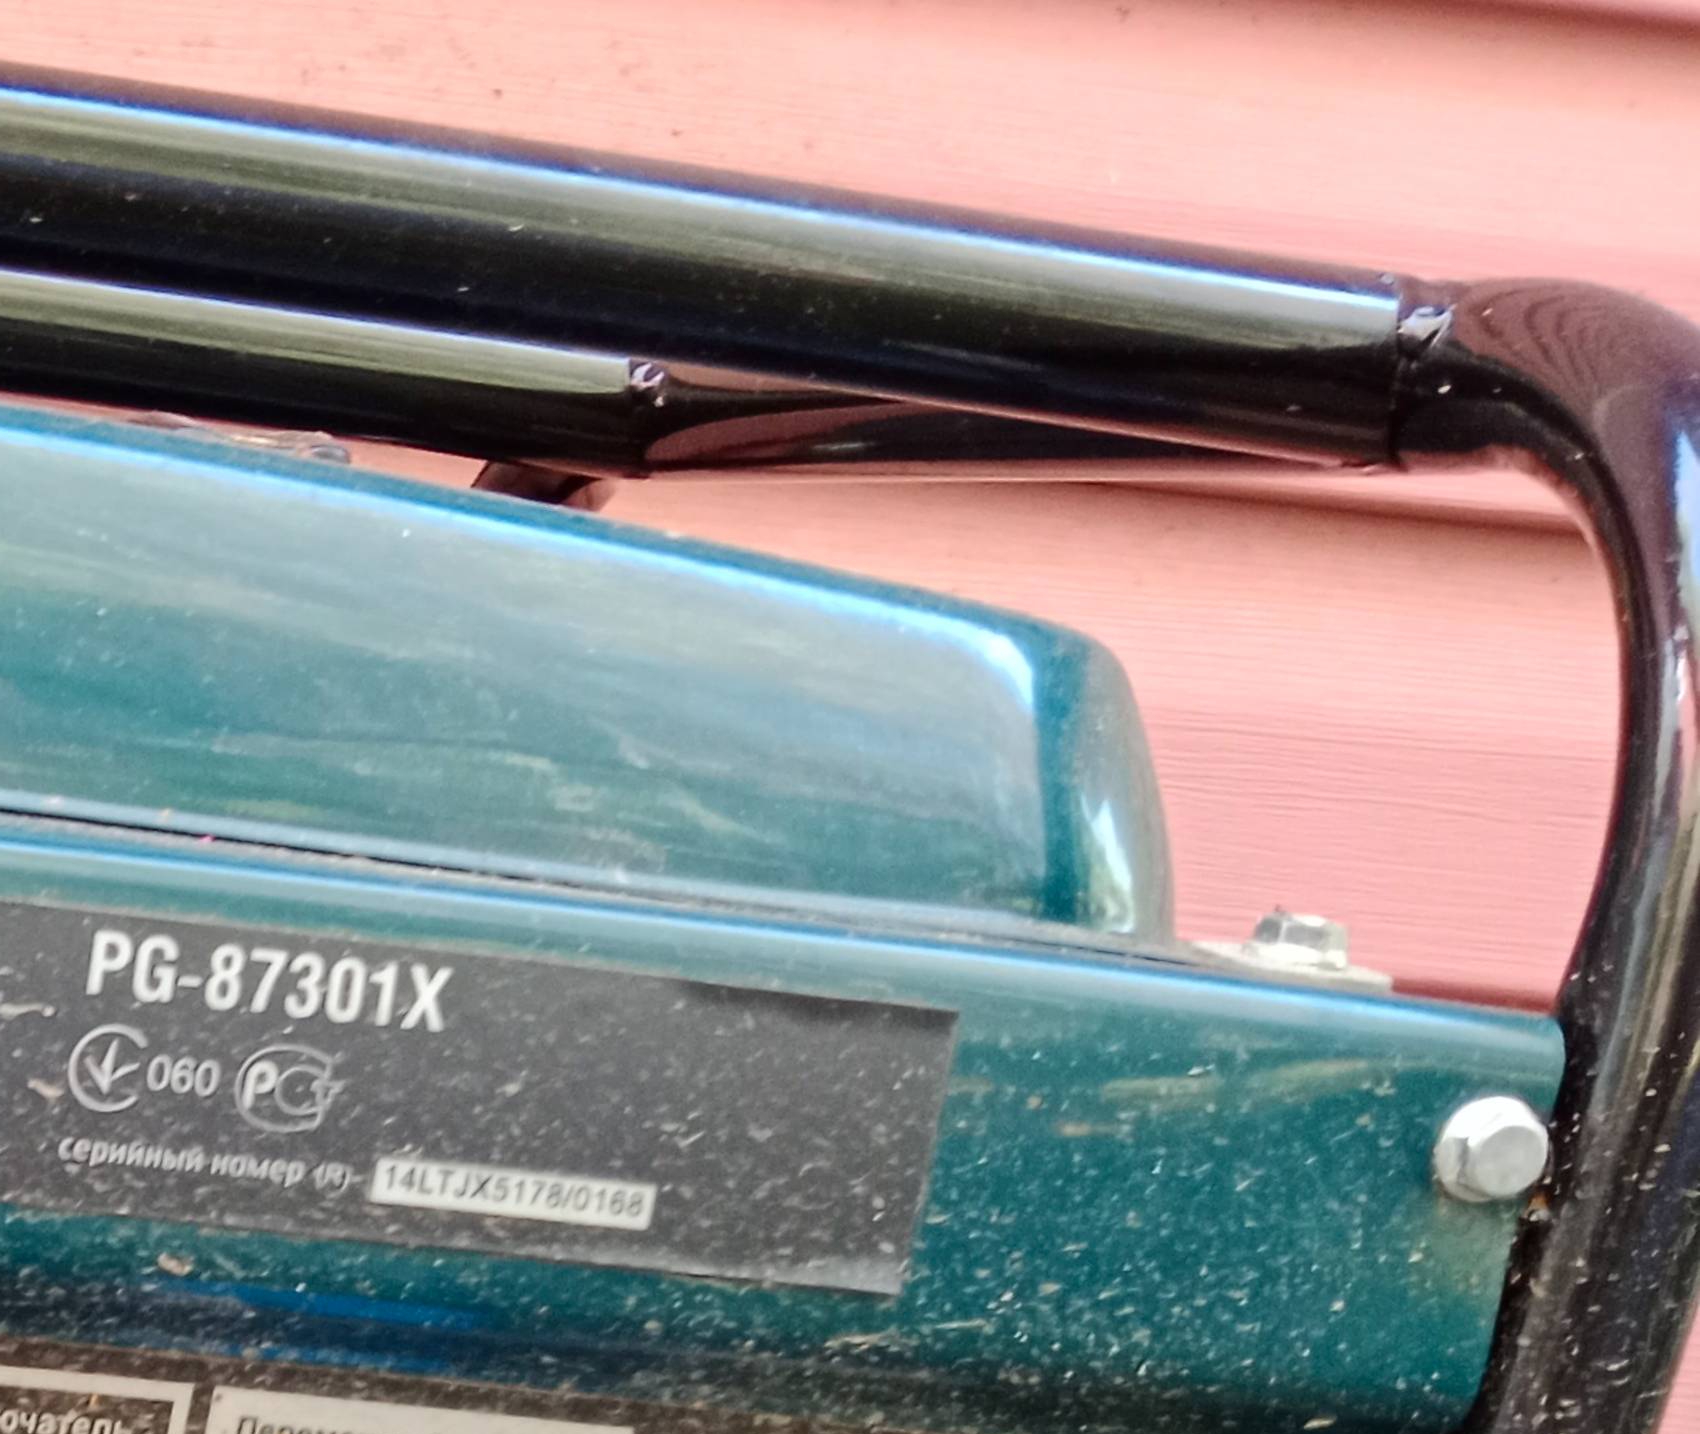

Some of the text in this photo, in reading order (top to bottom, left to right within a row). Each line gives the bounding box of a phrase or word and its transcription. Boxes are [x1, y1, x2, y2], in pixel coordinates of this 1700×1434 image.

[86, 929, 454, 1033] PG-87301X
[146, 1053, 222, 1097] 060
[57, 1137, 202, 1172] серийный
[210, 1153, 306, 1187] номер
